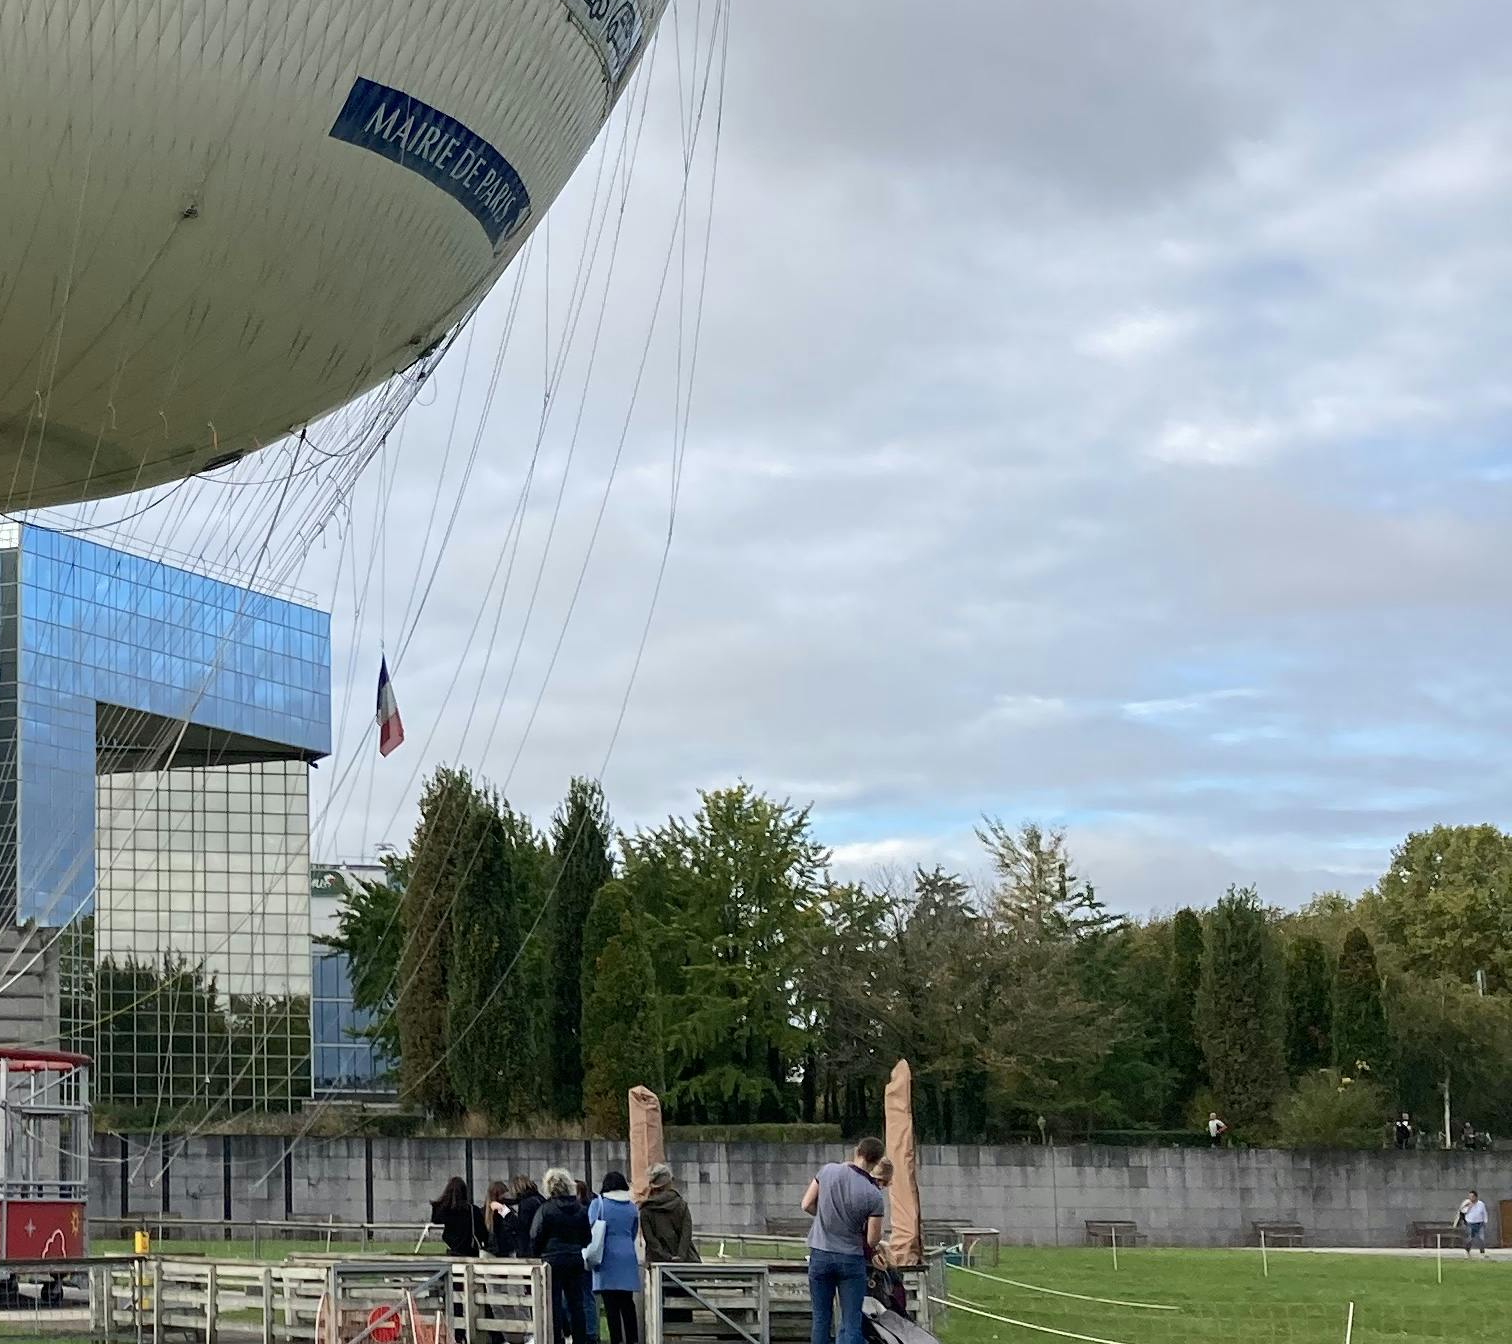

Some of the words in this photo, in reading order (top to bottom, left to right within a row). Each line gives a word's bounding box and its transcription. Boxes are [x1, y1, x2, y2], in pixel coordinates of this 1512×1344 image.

[364, 102, 460, 171] MAIRIE
[450, 147, 487, 188] DE
[475, 168, 516, 223] PARIS
